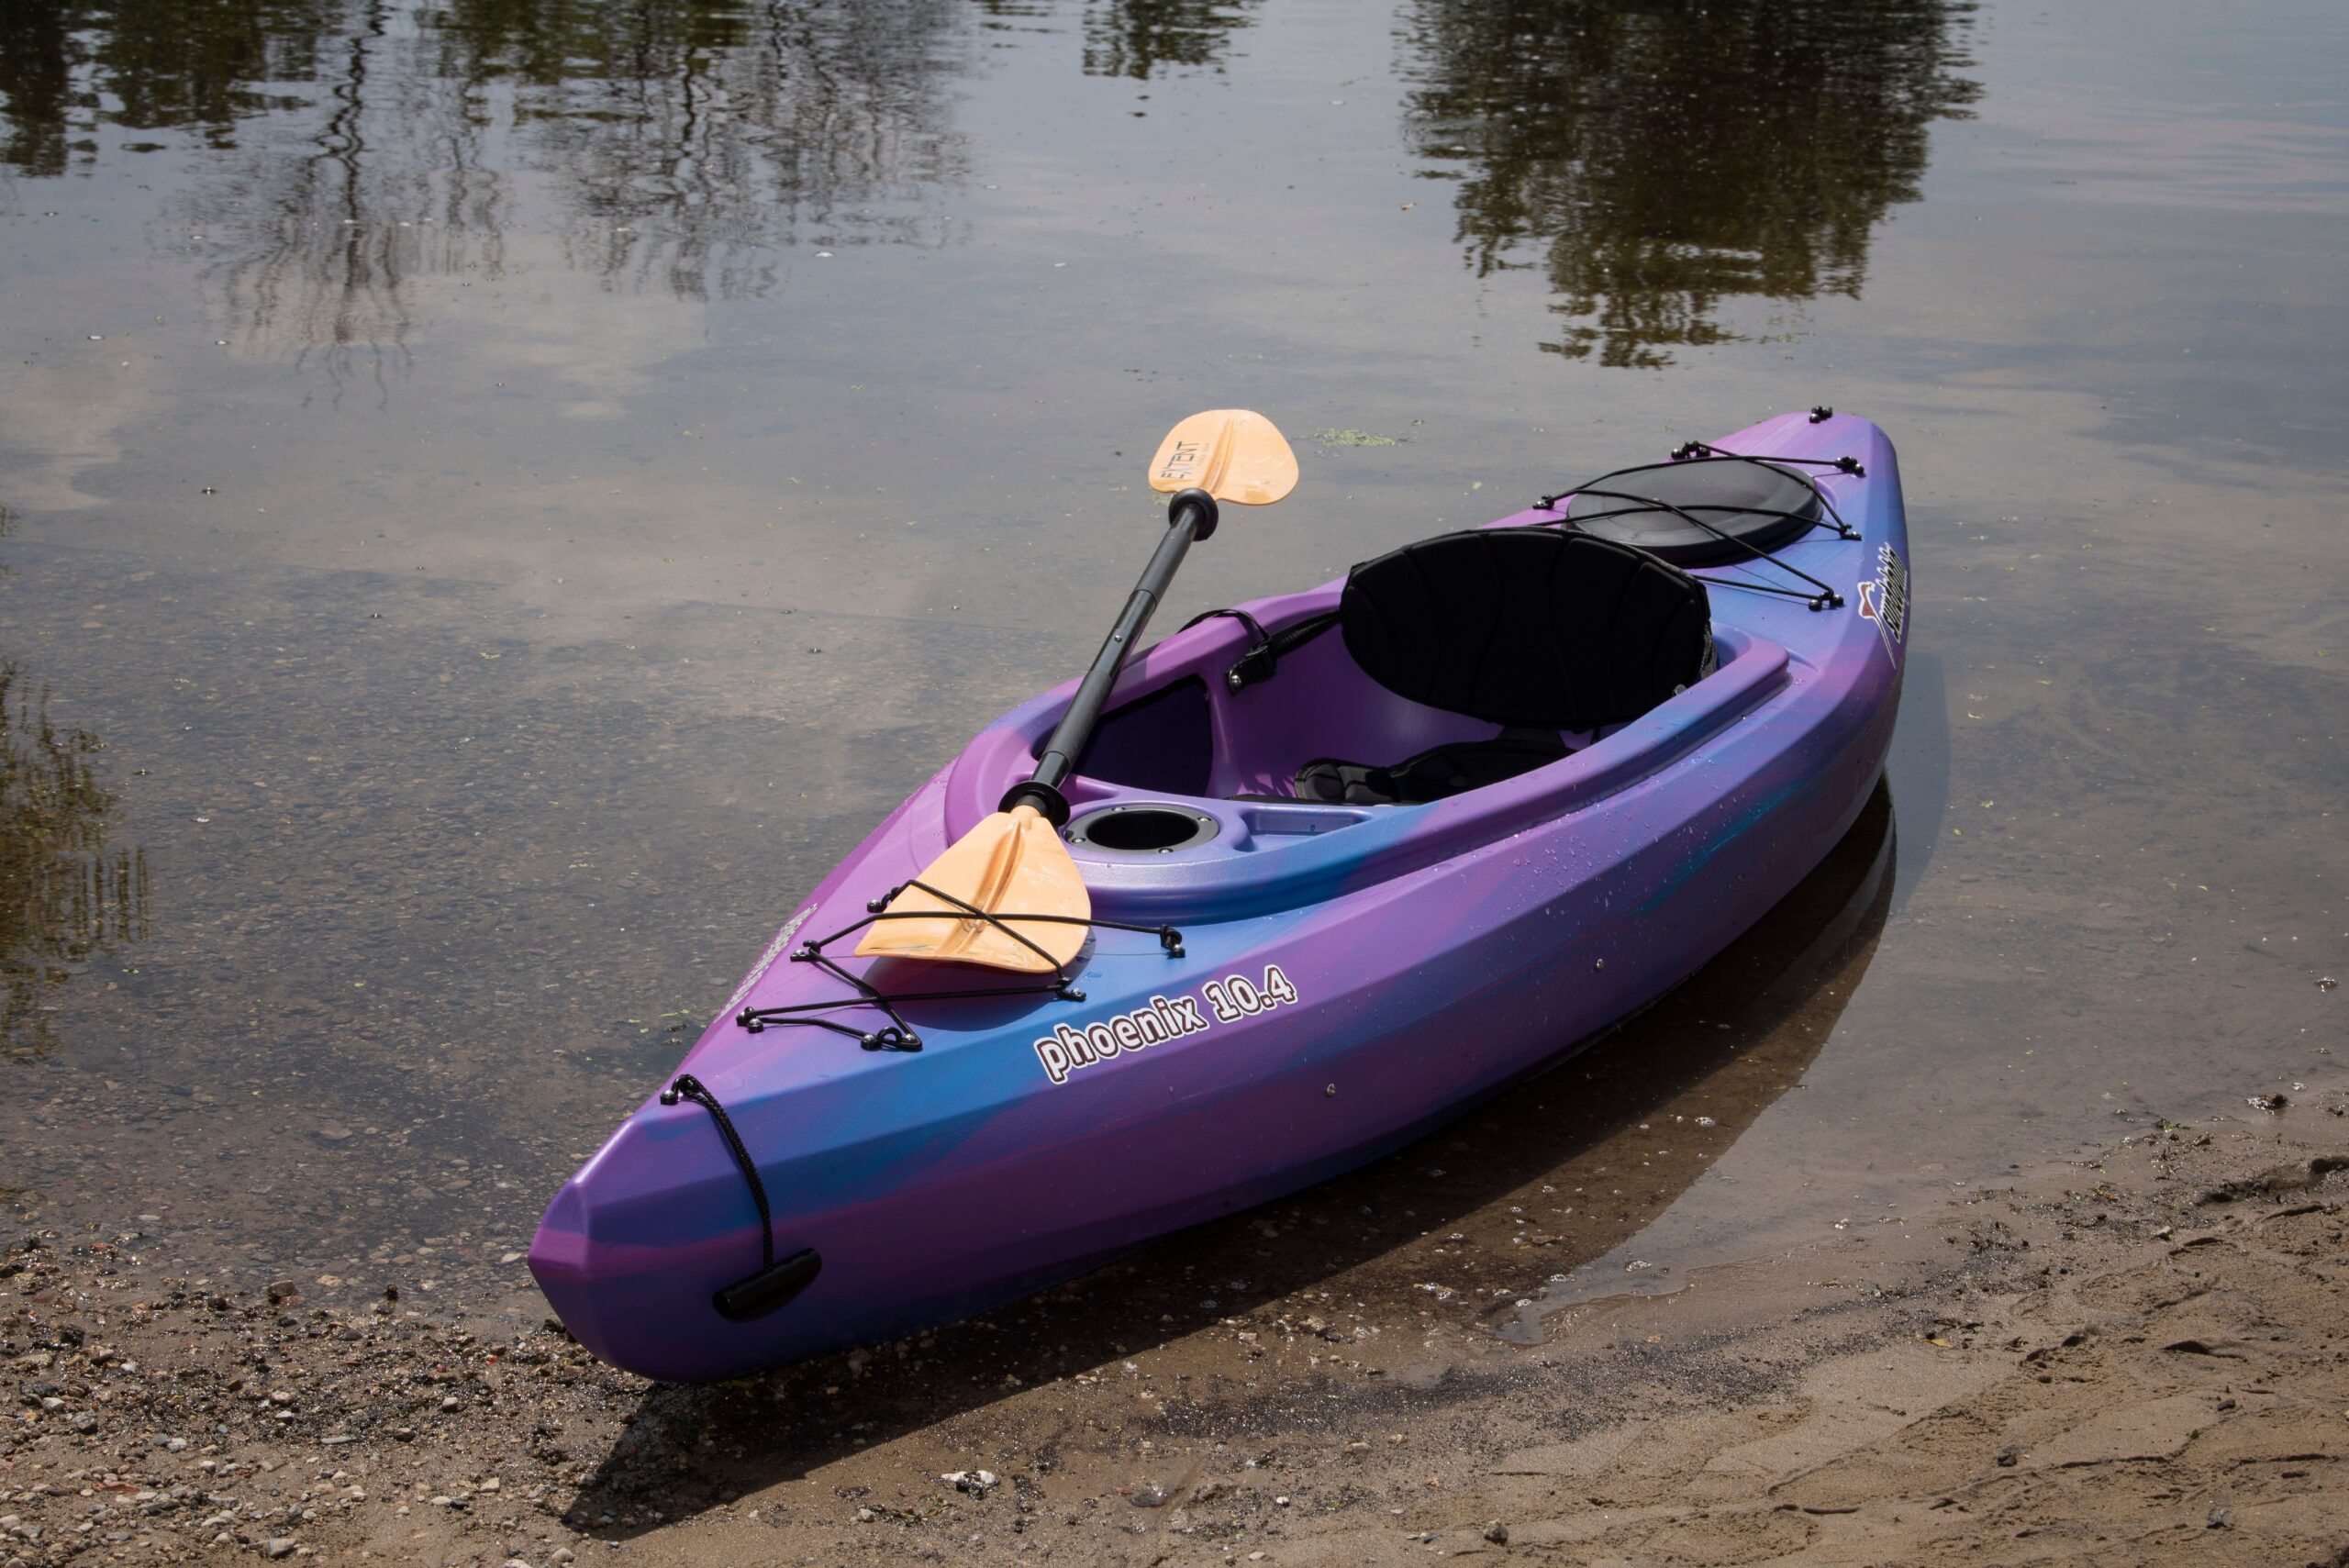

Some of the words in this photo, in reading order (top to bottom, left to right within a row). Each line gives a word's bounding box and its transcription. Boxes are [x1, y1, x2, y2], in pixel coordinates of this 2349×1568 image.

[1160, 440, 1199, 479] EXTENT
[1034, 995, 1209, 1084] phoenix
[1202, 964, 1297, 1024] 10.4
